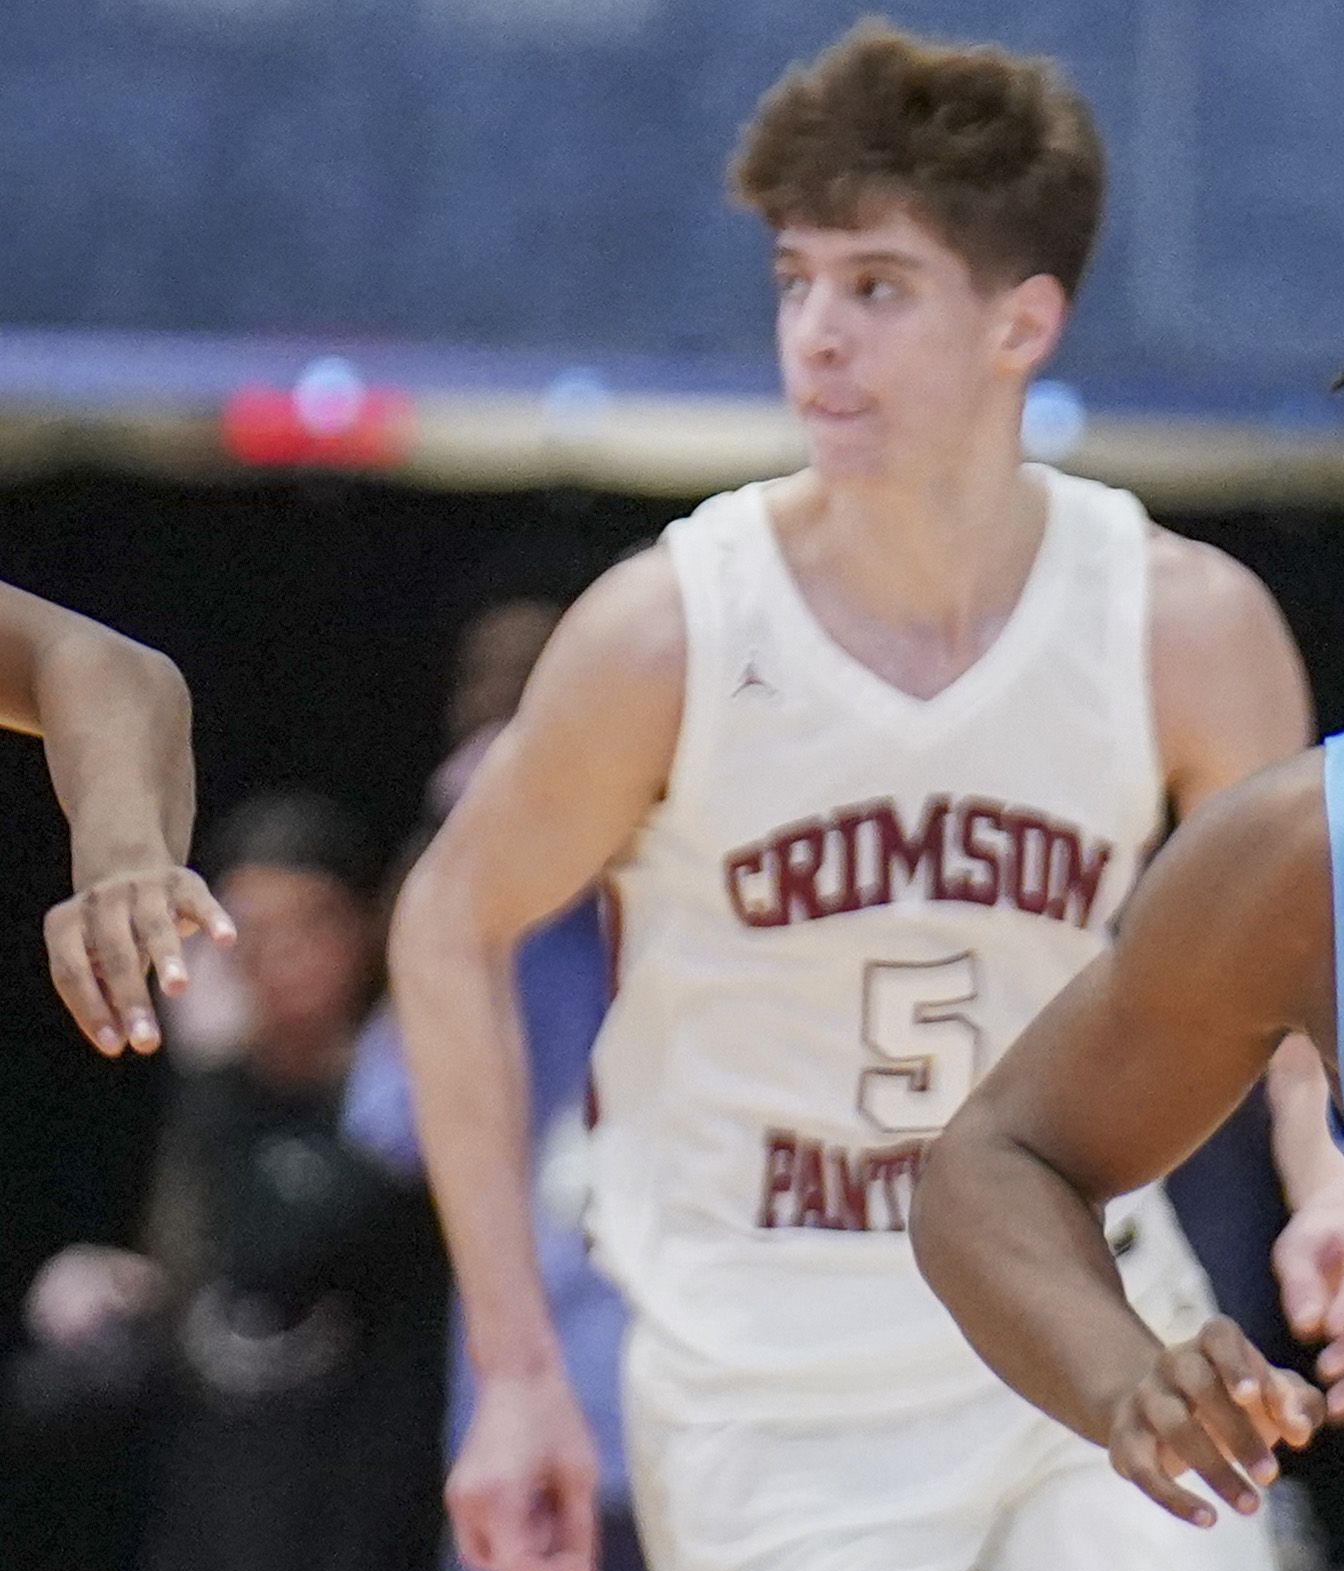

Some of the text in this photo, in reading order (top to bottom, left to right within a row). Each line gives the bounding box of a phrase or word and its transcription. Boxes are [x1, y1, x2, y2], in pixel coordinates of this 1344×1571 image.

[724, 794, 1113, 930] CRIMSON
[858, 952, 983, 1132] 5
[759, 1128, 930, 1231] PANT
